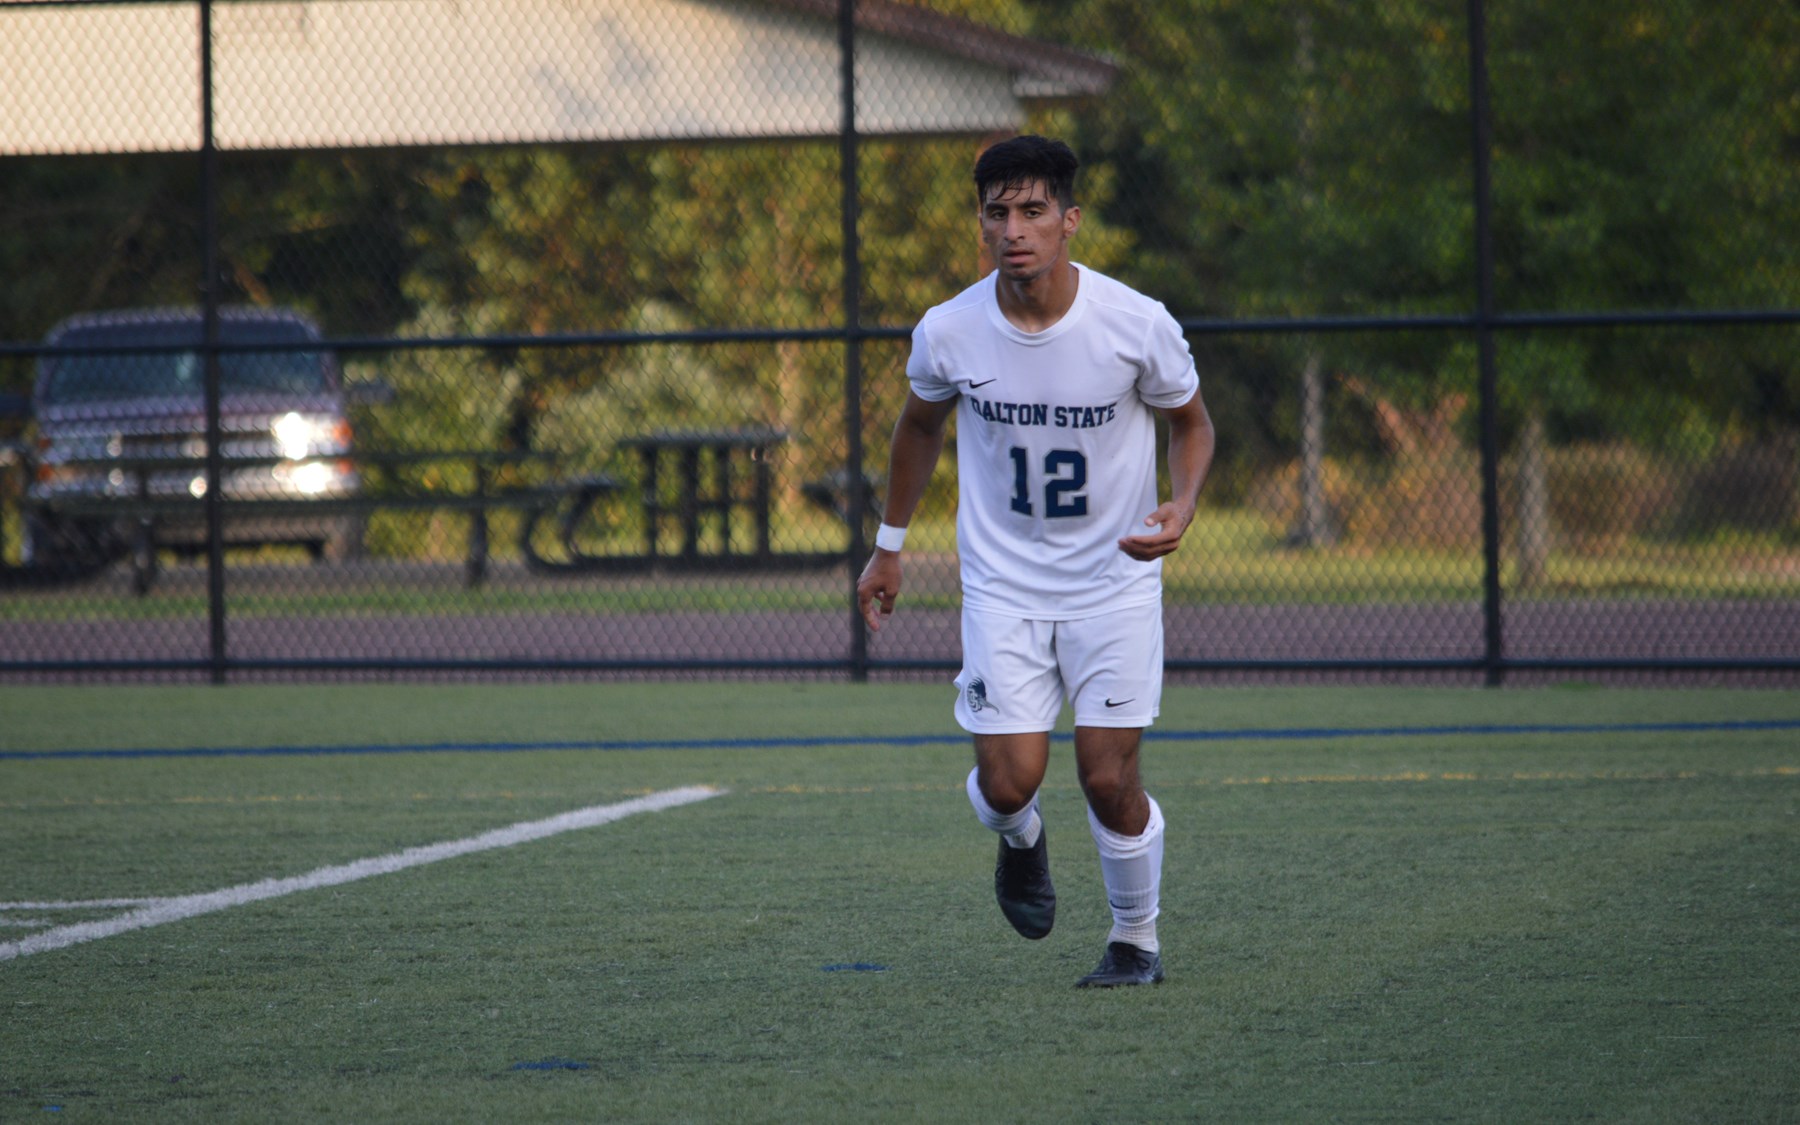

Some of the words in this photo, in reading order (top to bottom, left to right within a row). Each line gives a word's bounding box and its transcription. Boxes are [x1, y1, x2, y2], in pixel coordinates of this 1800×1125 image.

[970, 397, 1048, 426] DALTON
[1054, 402, 1118, 429] STATE
[1009, 446, 1088, 519] 12
